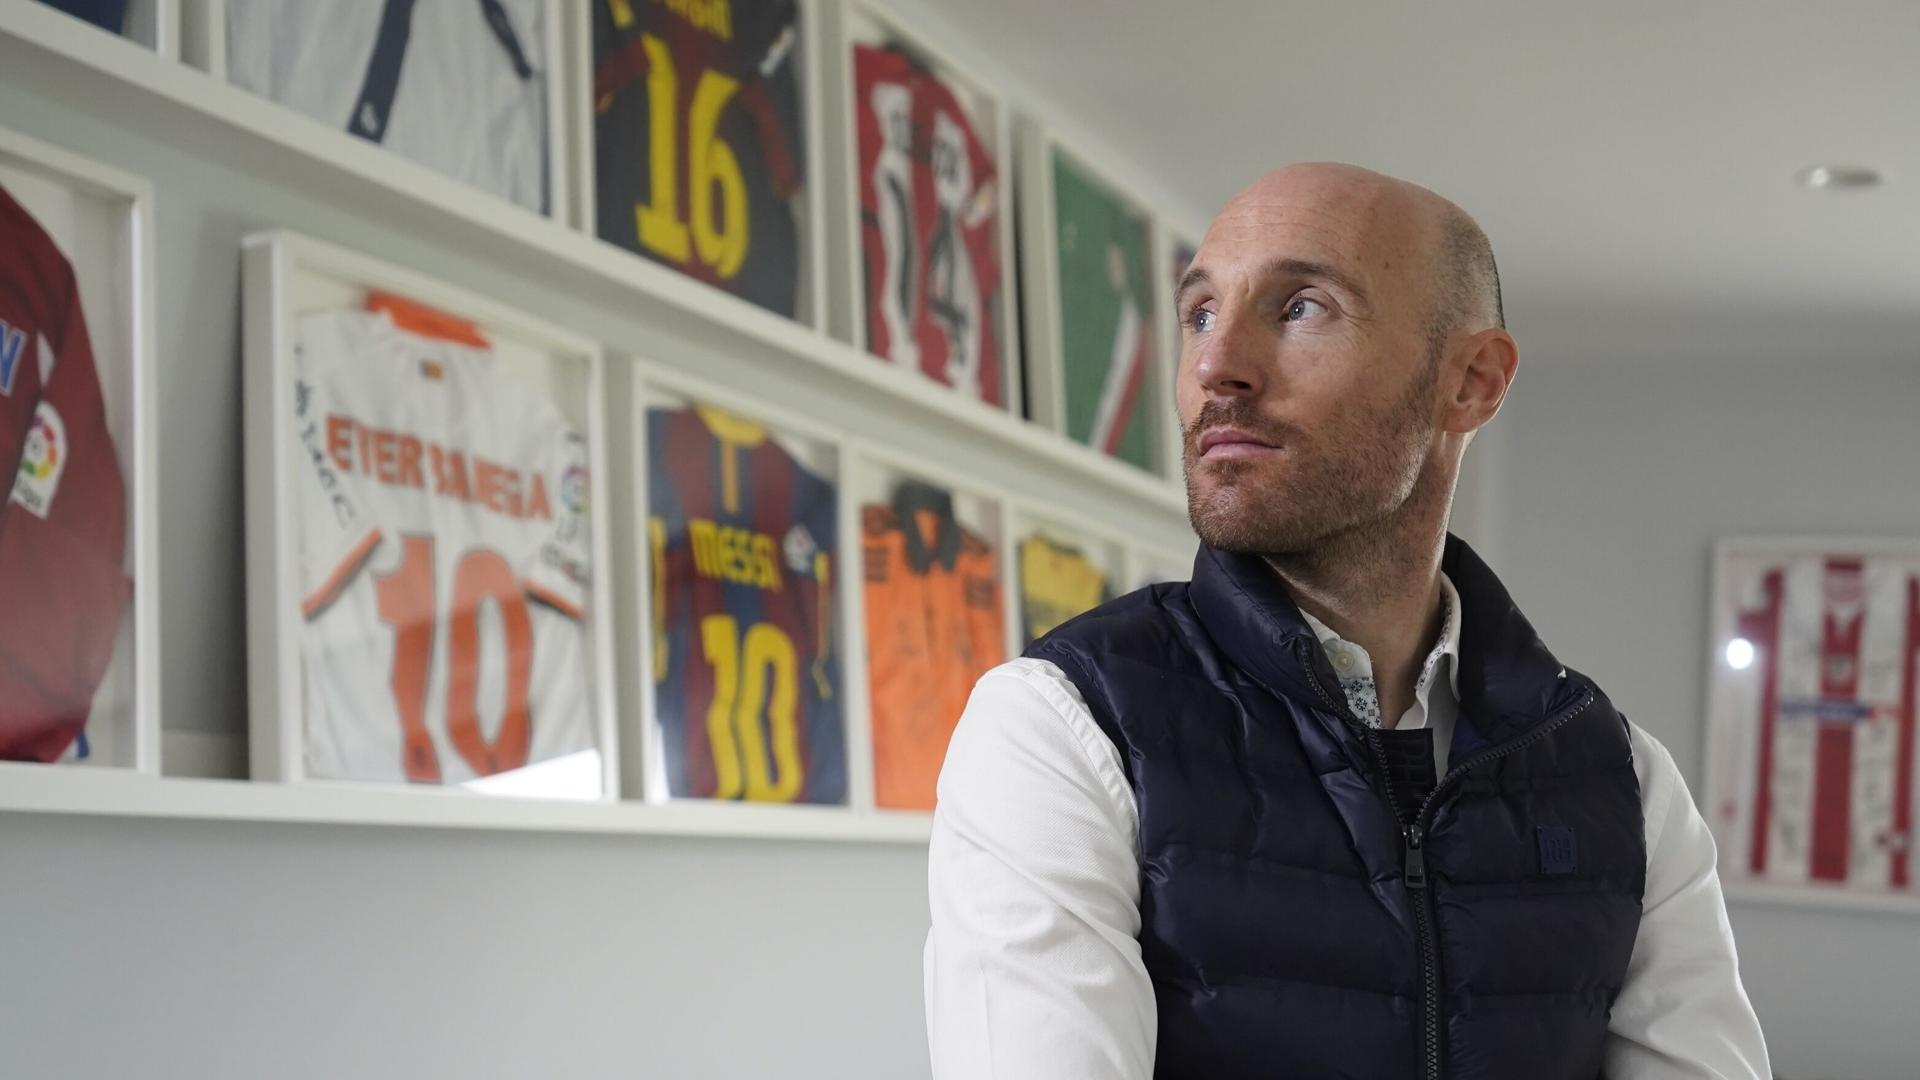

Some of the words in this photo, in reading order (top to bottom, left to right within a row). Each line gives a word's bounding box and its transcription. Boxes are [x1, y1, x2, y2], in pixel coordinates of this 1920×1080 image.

[635, 33, 749, 279] 16
[372, 531, 534, 784] 10
[689, 517, 783, 592] MESSI
[702, 614, 804, 802] 10
